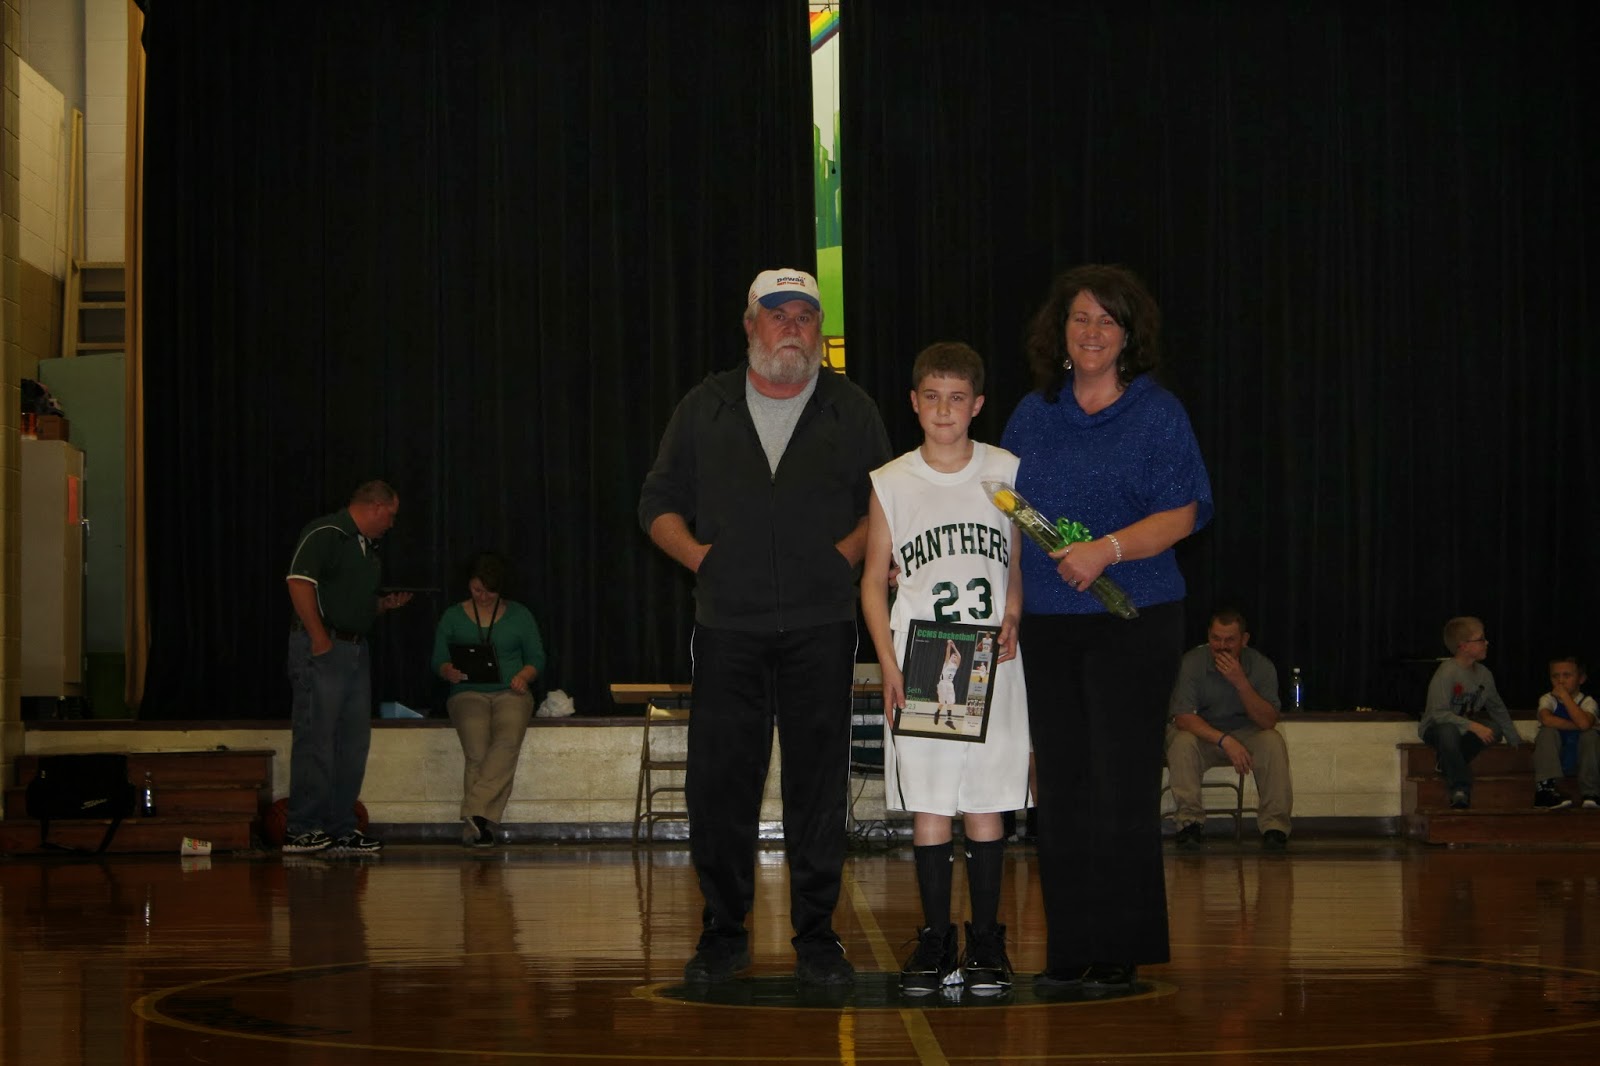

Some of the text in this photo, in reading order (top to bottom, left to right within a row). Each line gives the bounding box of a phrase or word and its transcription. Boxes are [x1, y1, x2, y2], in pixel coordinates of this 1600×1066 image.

[900, 523, 1009, 578] PANTHERS
[932, 577, 993, 623] 23
[938, 631, 976, 641] Basketball
